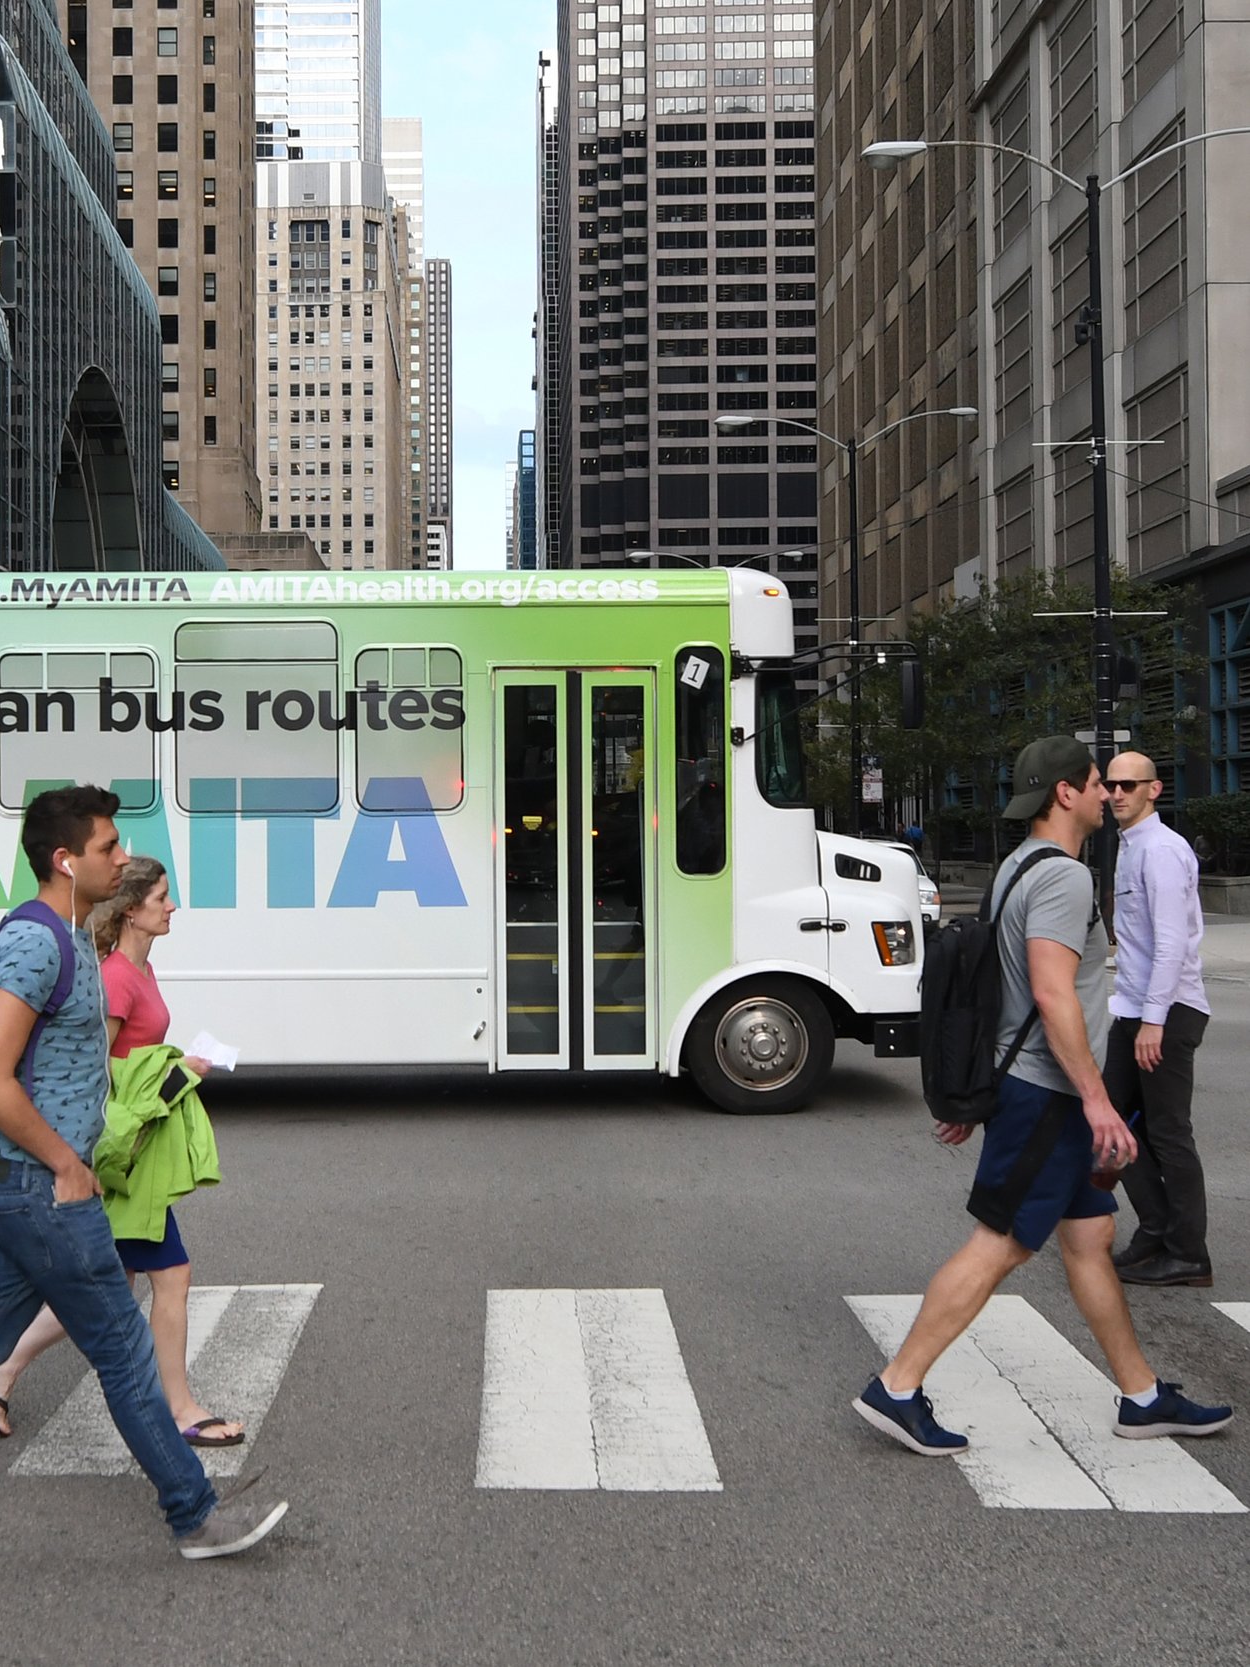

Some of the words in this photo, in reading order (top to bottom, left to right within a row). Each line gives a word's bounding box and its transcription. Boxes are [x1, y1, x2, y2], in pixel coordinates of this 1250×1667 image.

[209, 575, 660, 607] AMITAhealth.org/access
[687, 663, 701, 683] 1
[99, 677, 225, 732] bus
[246, 680, 467, 731] routes
